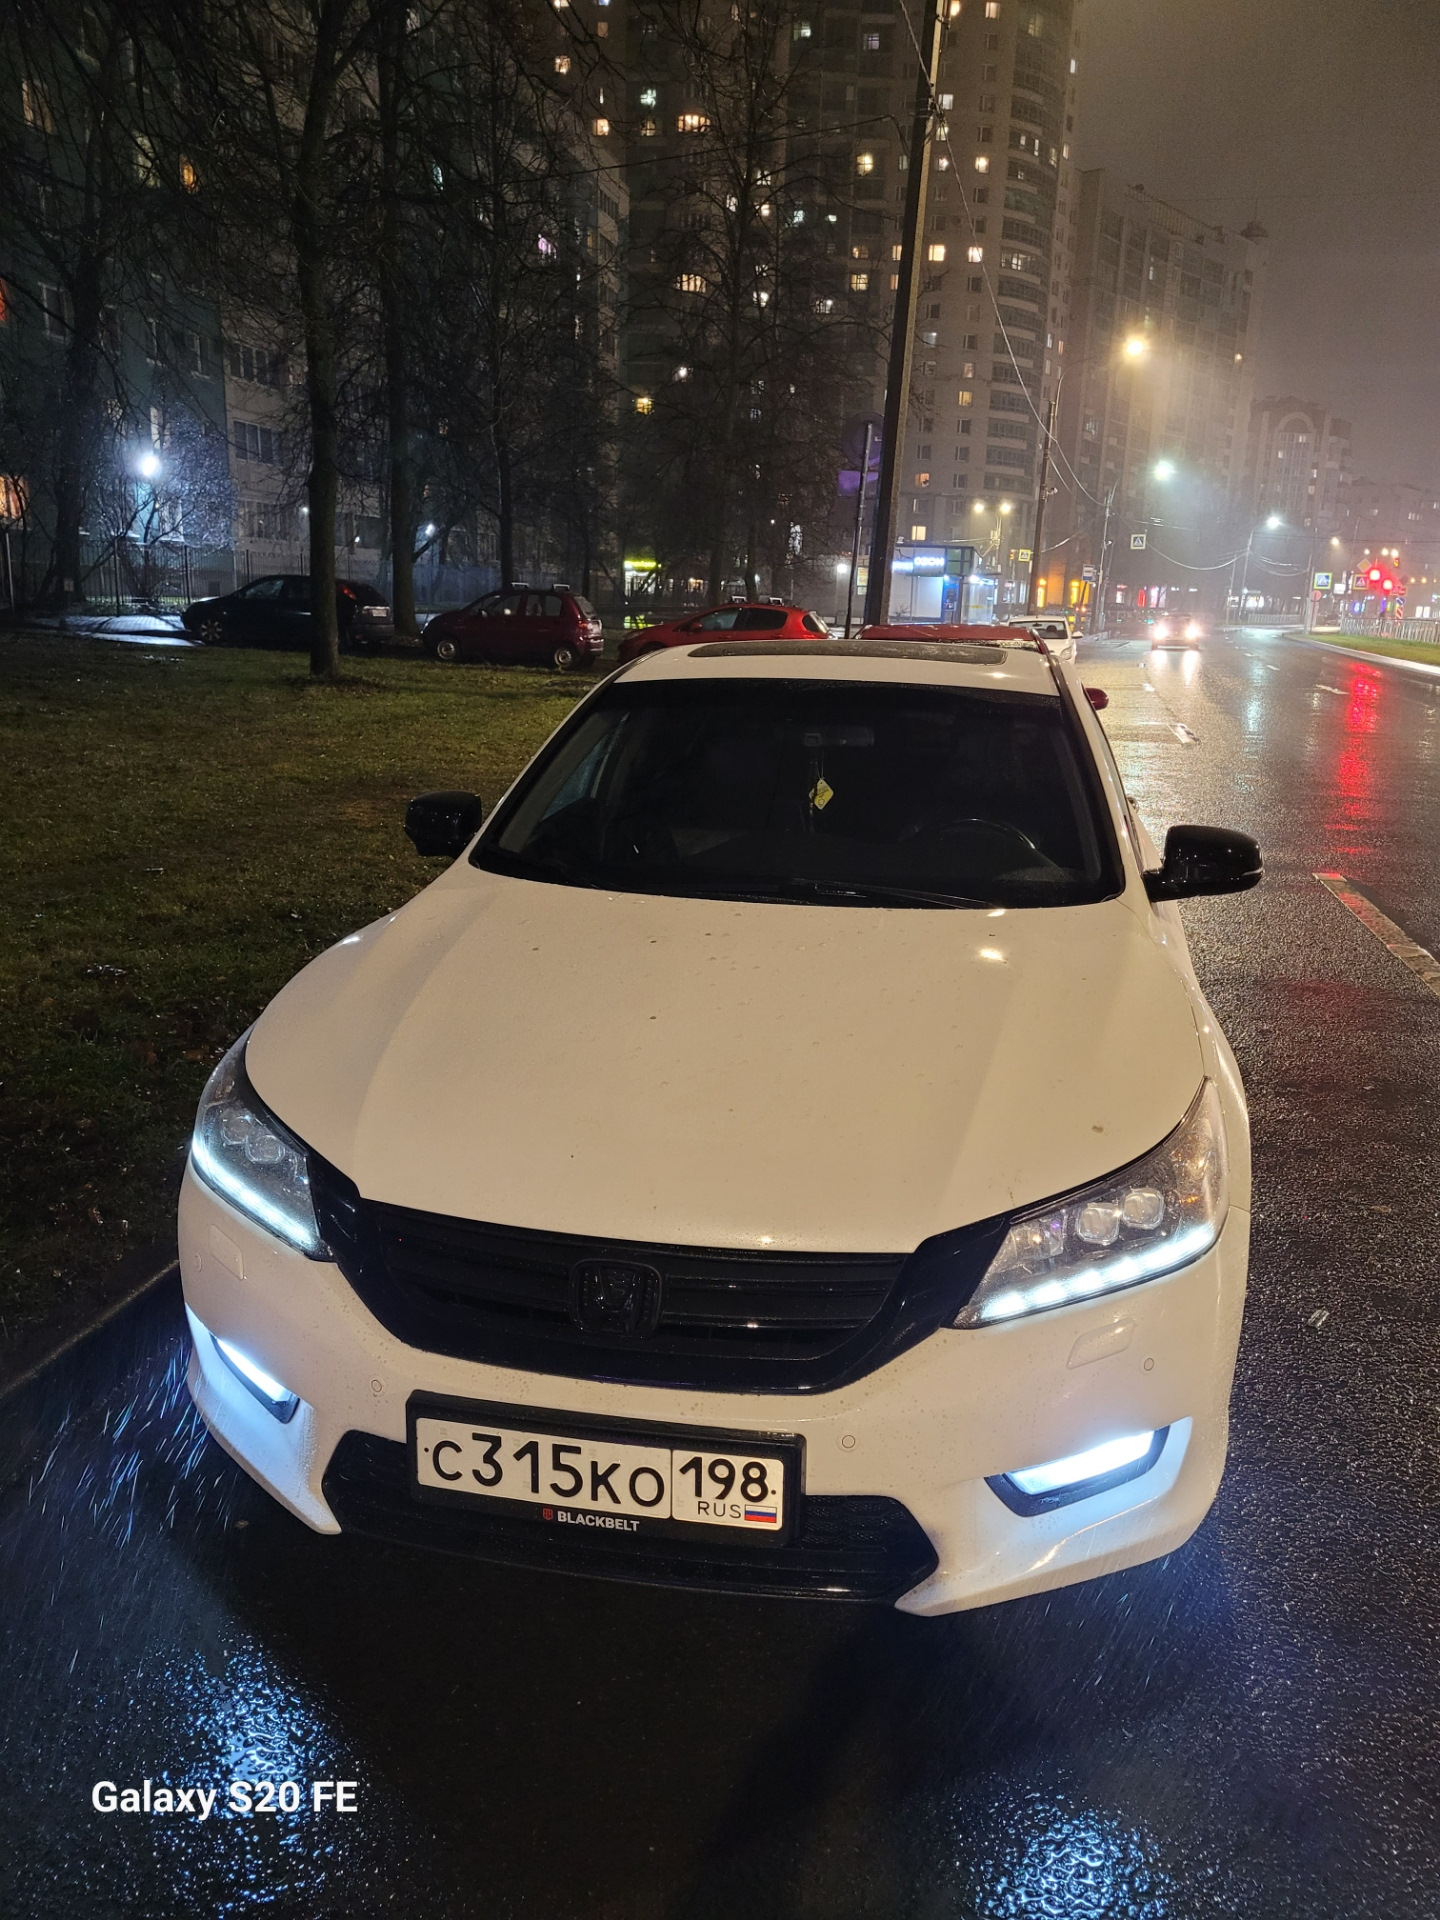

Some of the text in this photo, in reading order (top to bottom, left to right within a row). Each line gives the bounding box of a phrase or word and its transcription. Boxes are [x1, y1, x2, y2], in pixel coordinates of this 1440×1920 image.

[679, 1456, 769, 1503] 198
[697, 1500, 742, 1519] RUS
[557, 1510, 640, 1532] BLACKBELT
